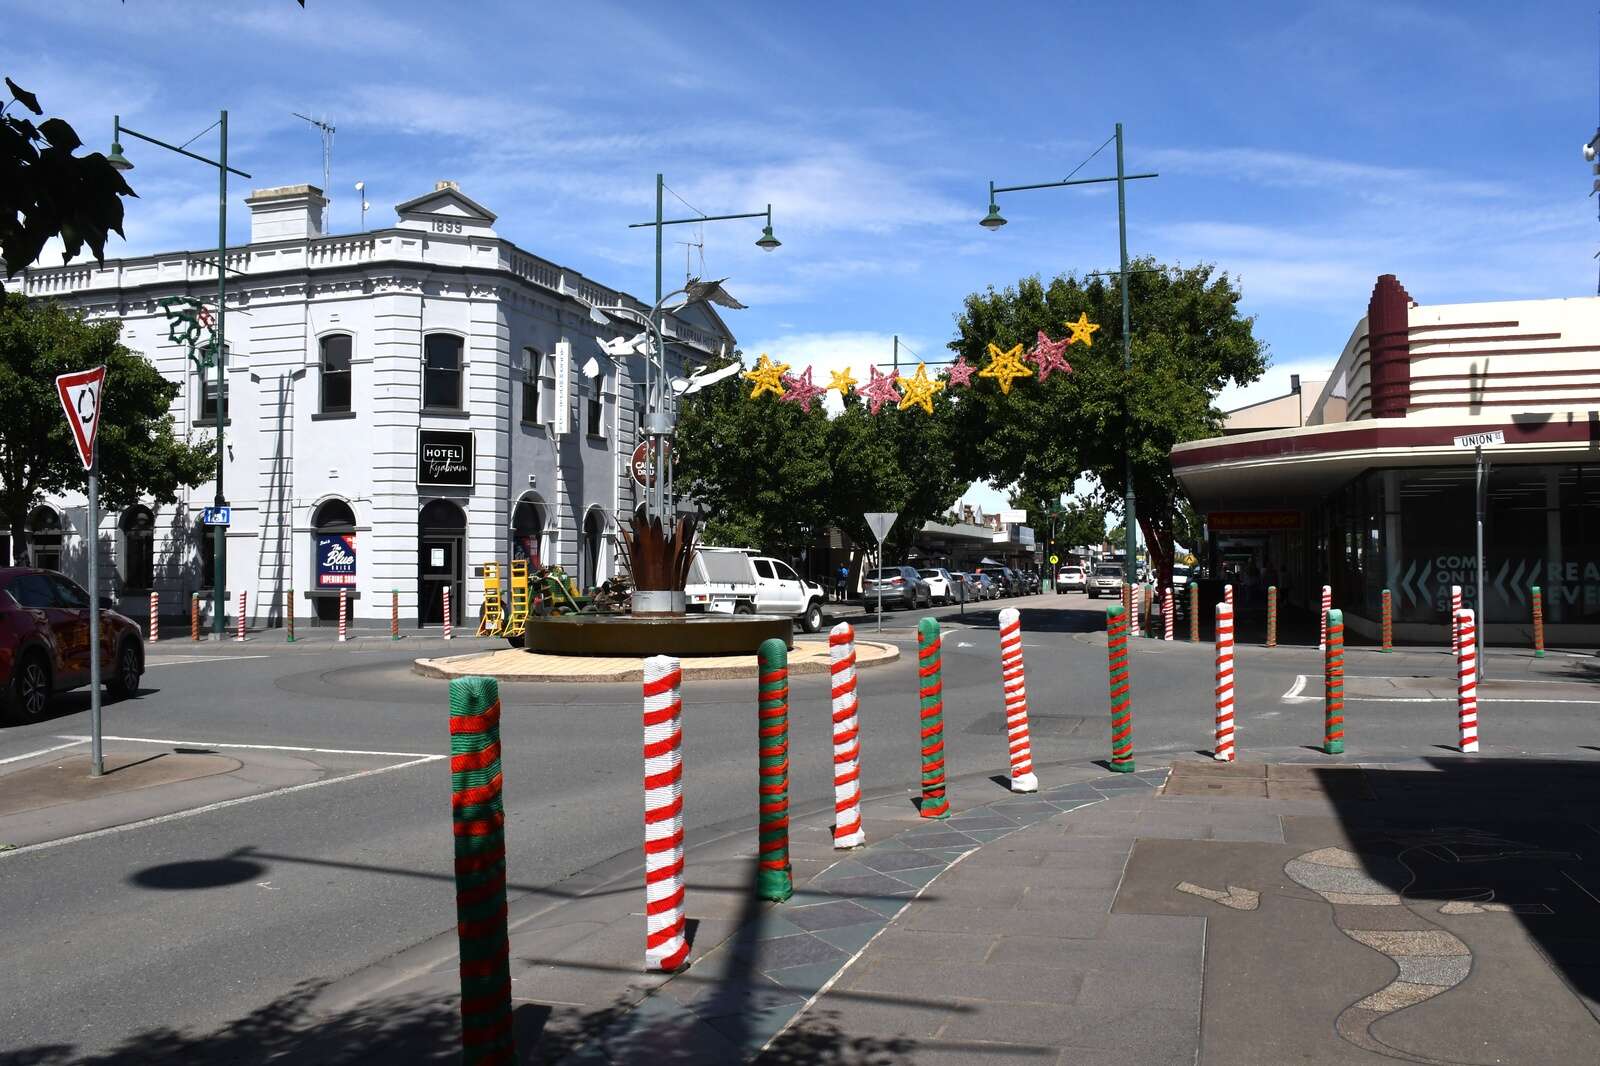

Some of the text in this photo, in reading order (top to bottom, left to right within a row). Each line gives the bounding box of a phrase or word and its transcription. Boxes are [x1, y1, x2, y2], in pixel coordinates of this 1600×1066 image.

[432, 218, 462, 234] 1899
[1462, 434, 1493, 447] UNION
[426, 449, 460, 458] HOTEL
[322, 550, 354, 567] Blue
[1436, 570, 1464, 583] ON
[1436, 585, 1477, 598] AD
[1547, 586, 1600, 605] EVE
